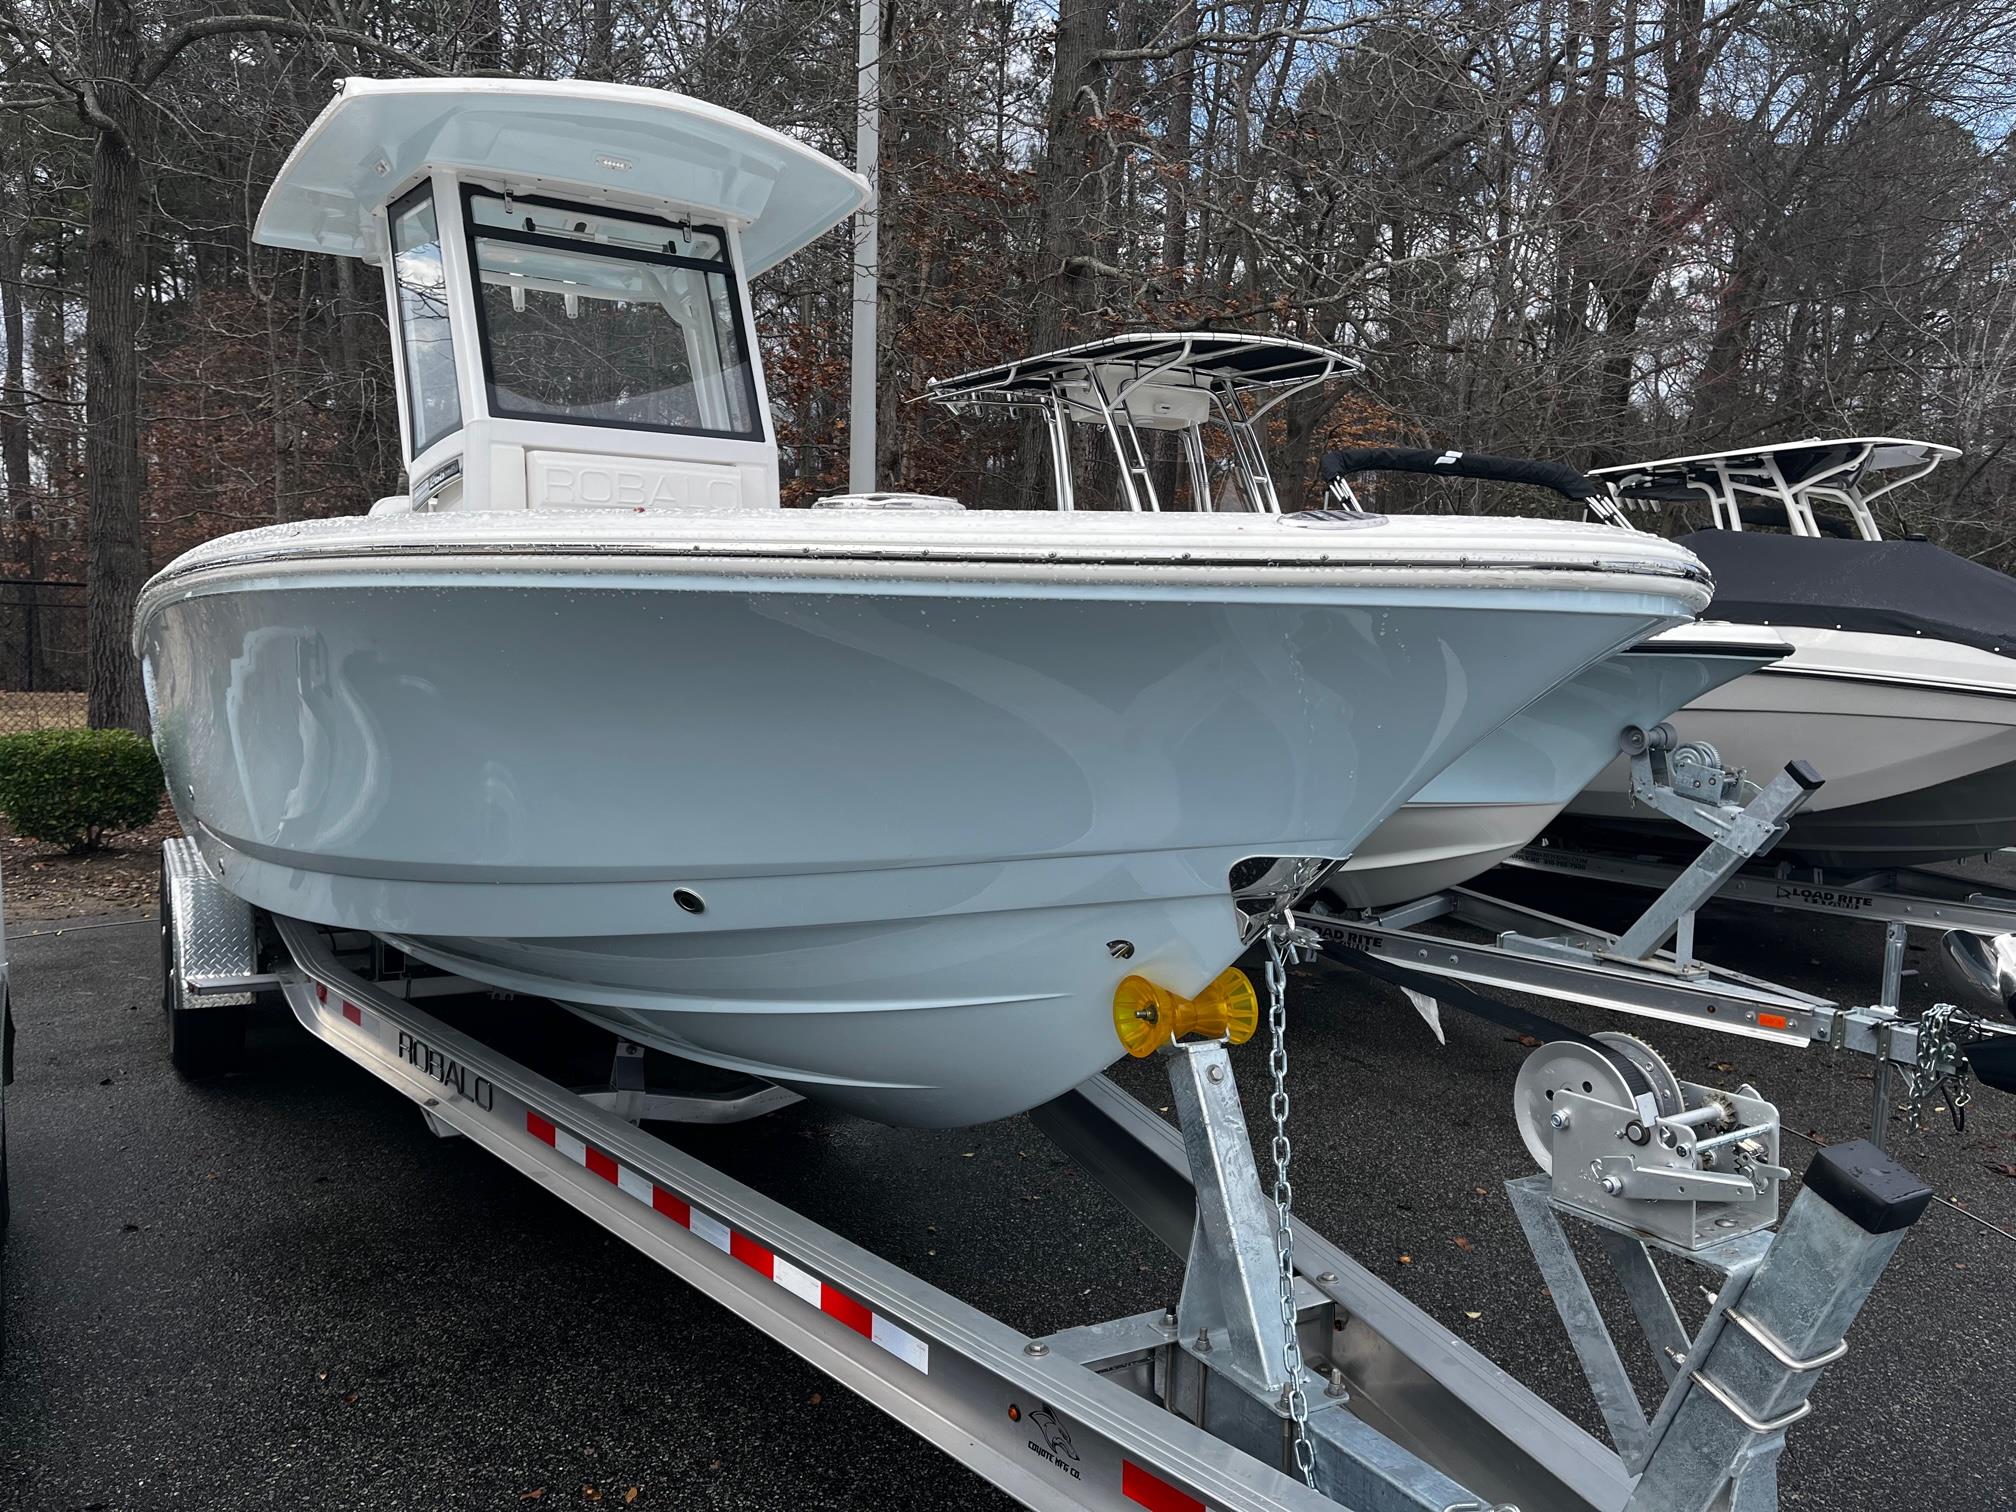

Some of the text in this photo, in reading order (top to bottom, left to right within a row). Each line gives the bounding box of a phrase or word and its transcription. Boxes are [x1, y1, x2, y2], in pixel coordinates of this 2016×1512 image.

[544, 467, 741, 508] ROBALO
[1792, 888, 1834, 901] LOAD
[1838, 894, 1873, 907] RITE
[1348, 932, 1383, 948] RITE
[398, 1031, 493, 1112] ROBALO
[1027, 1440, 1081, 1480] COYOTE MFG CO.
